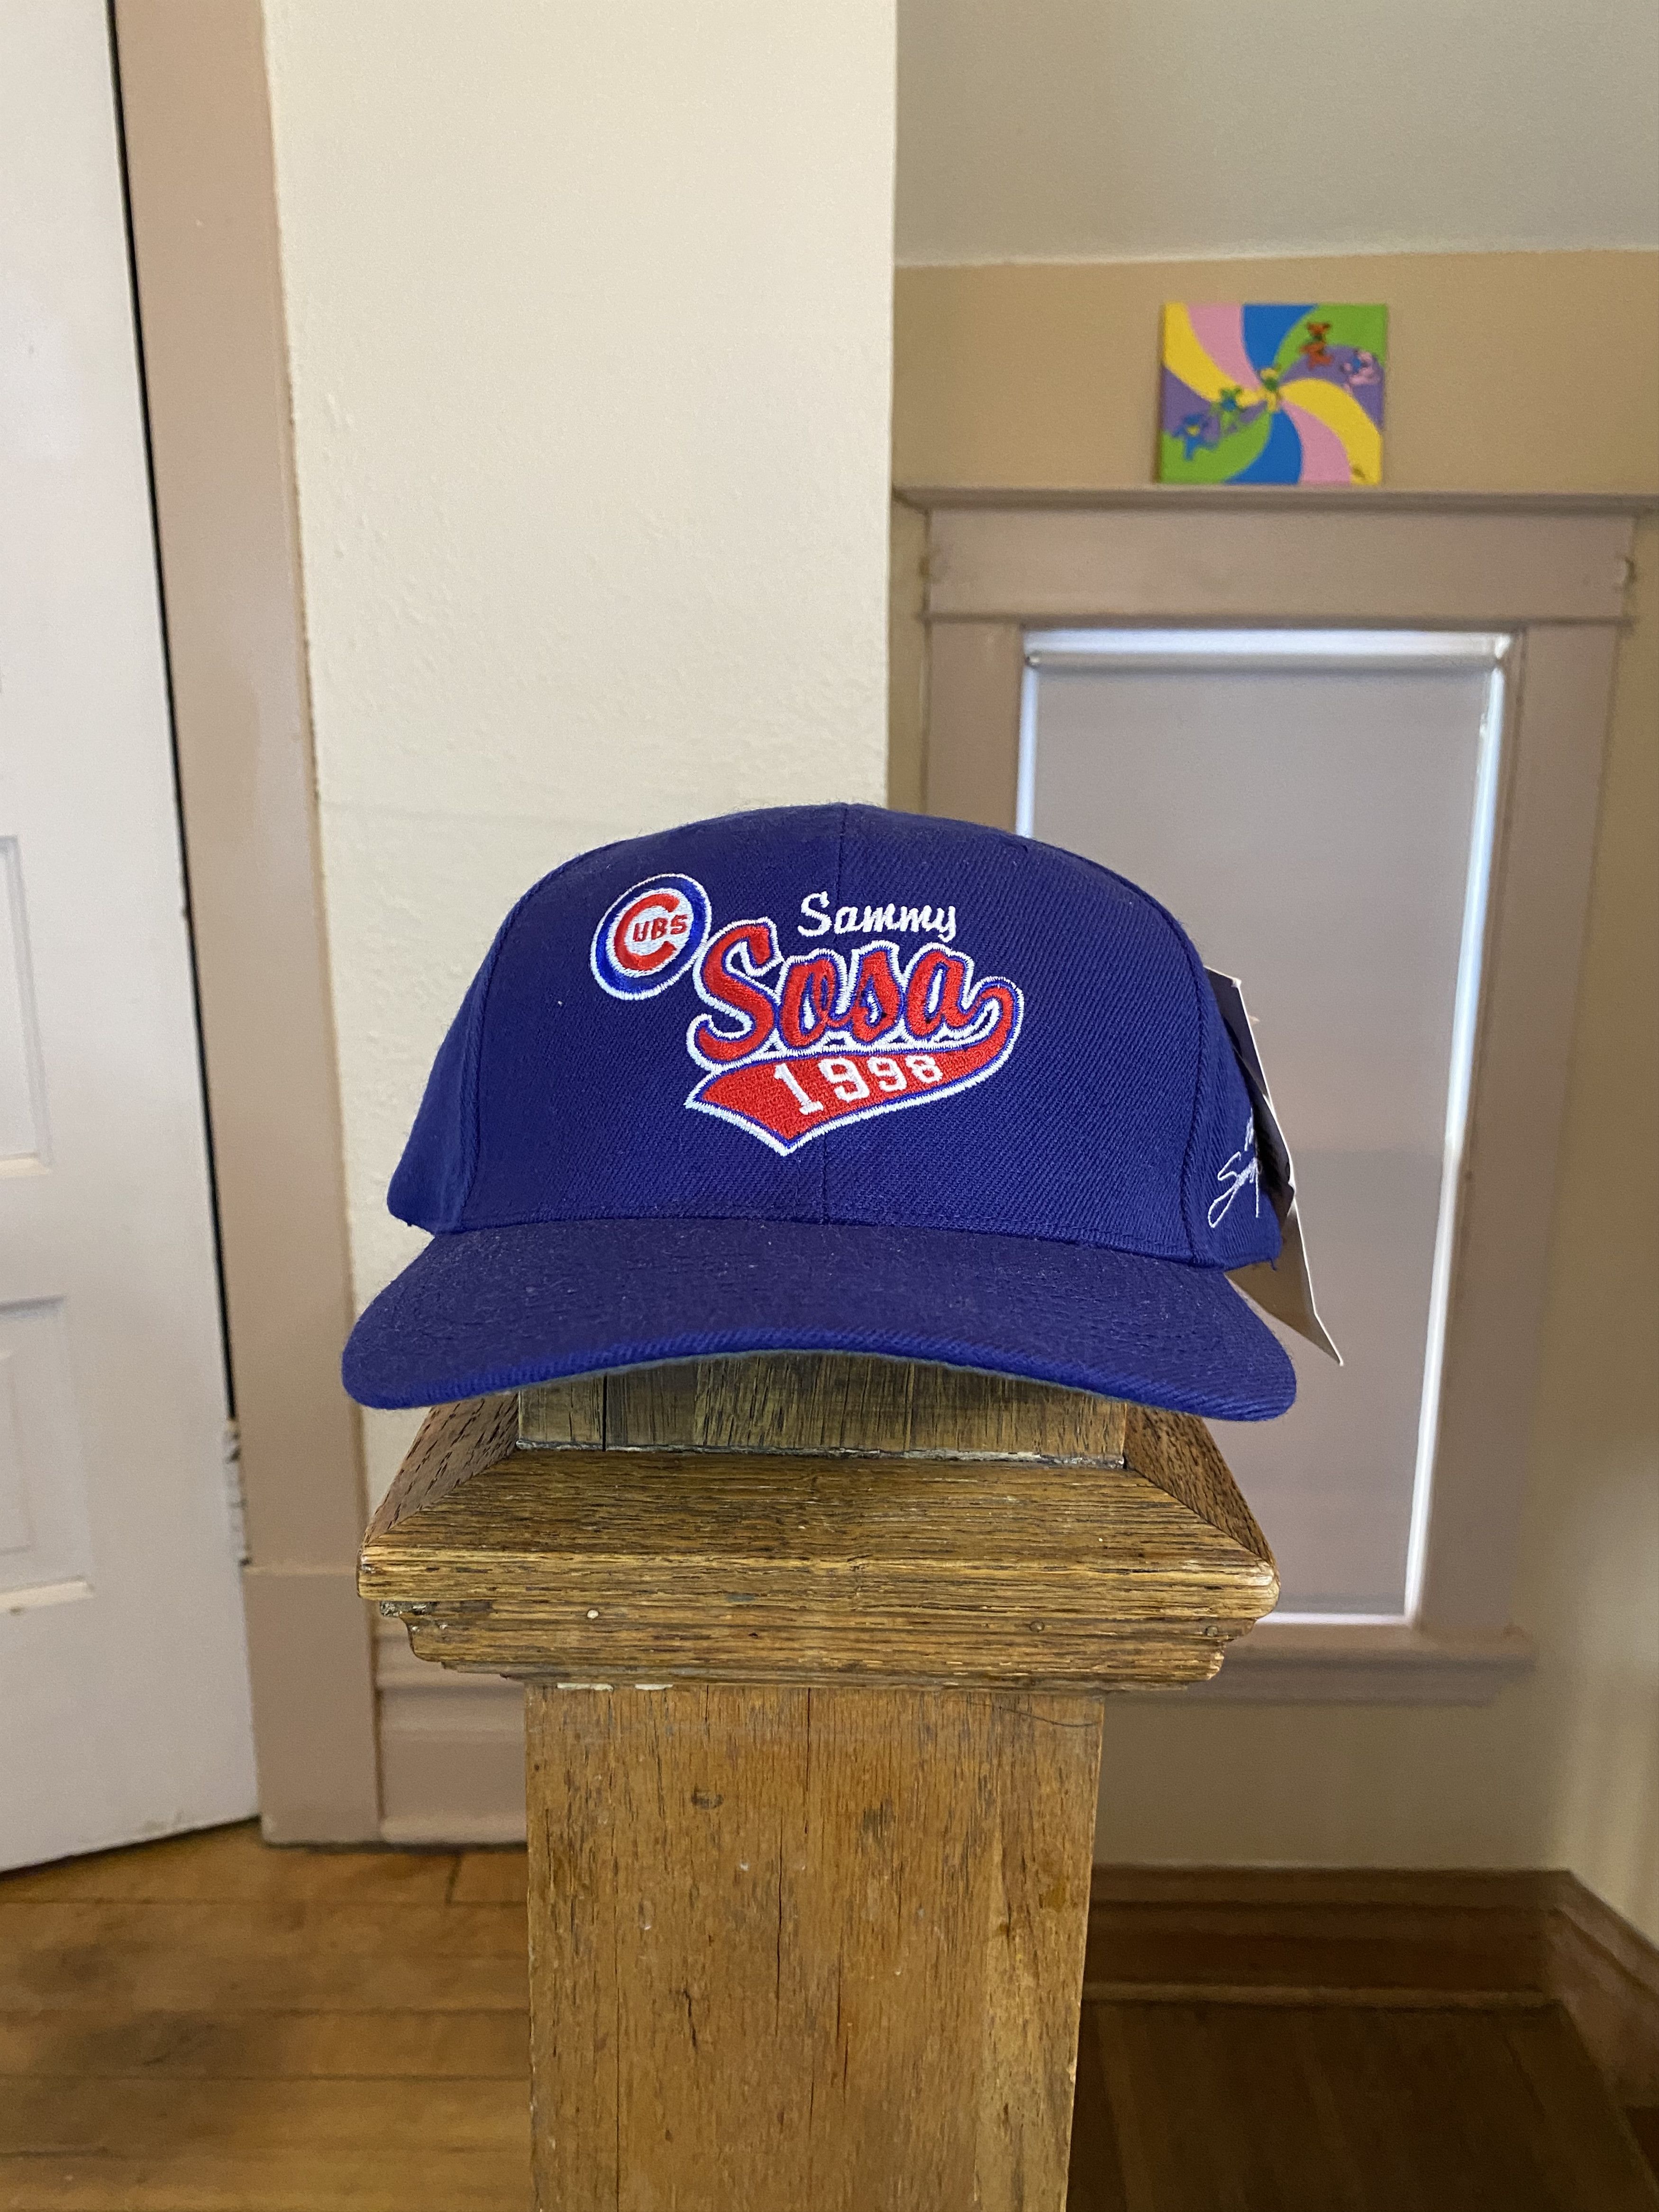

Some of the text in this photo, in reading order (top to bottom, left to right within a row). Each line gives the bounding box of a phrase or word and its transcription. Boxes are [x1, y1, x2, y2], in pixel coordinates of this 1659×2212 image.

[613, 893, 689, 972] CUBS
[797, 891, 957, 941] Sammy
[687, 917, 1003, 1072] Sosa
[773, 1054, 944, 1116] 1998
